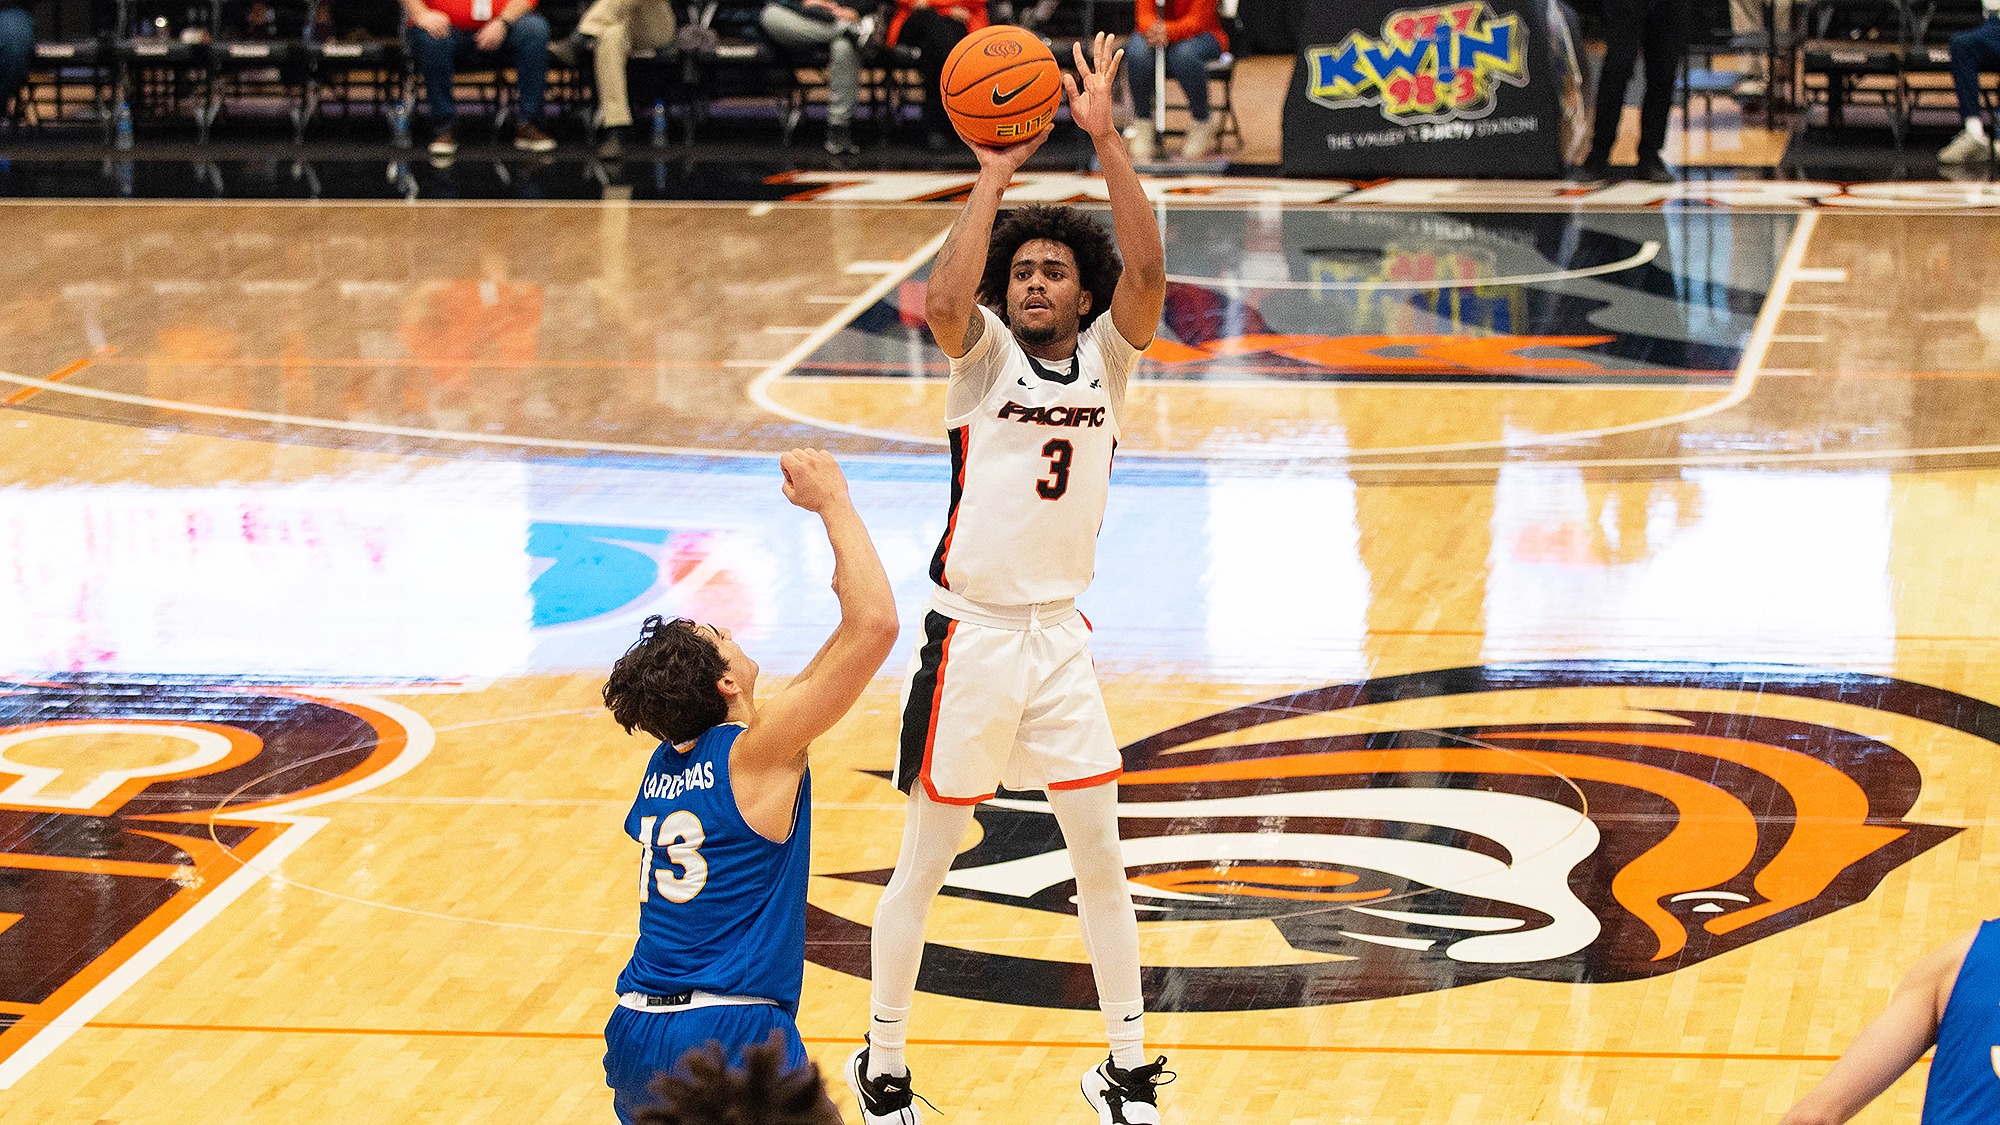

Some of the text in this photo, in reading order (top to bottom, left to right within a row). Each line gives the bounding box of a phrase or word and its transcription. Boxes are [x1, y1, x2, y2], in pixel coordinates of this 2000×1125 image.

[1319, 24, 1510, 87] KWIN
[996, 107, 1053, 137] ELITE
[1326, 132, 1353, 149] THE
[997, 400, 1106, 428] PACIFIC
[1035, 437, 1075, 501] 3
[639, 810, 708, 903] 13
